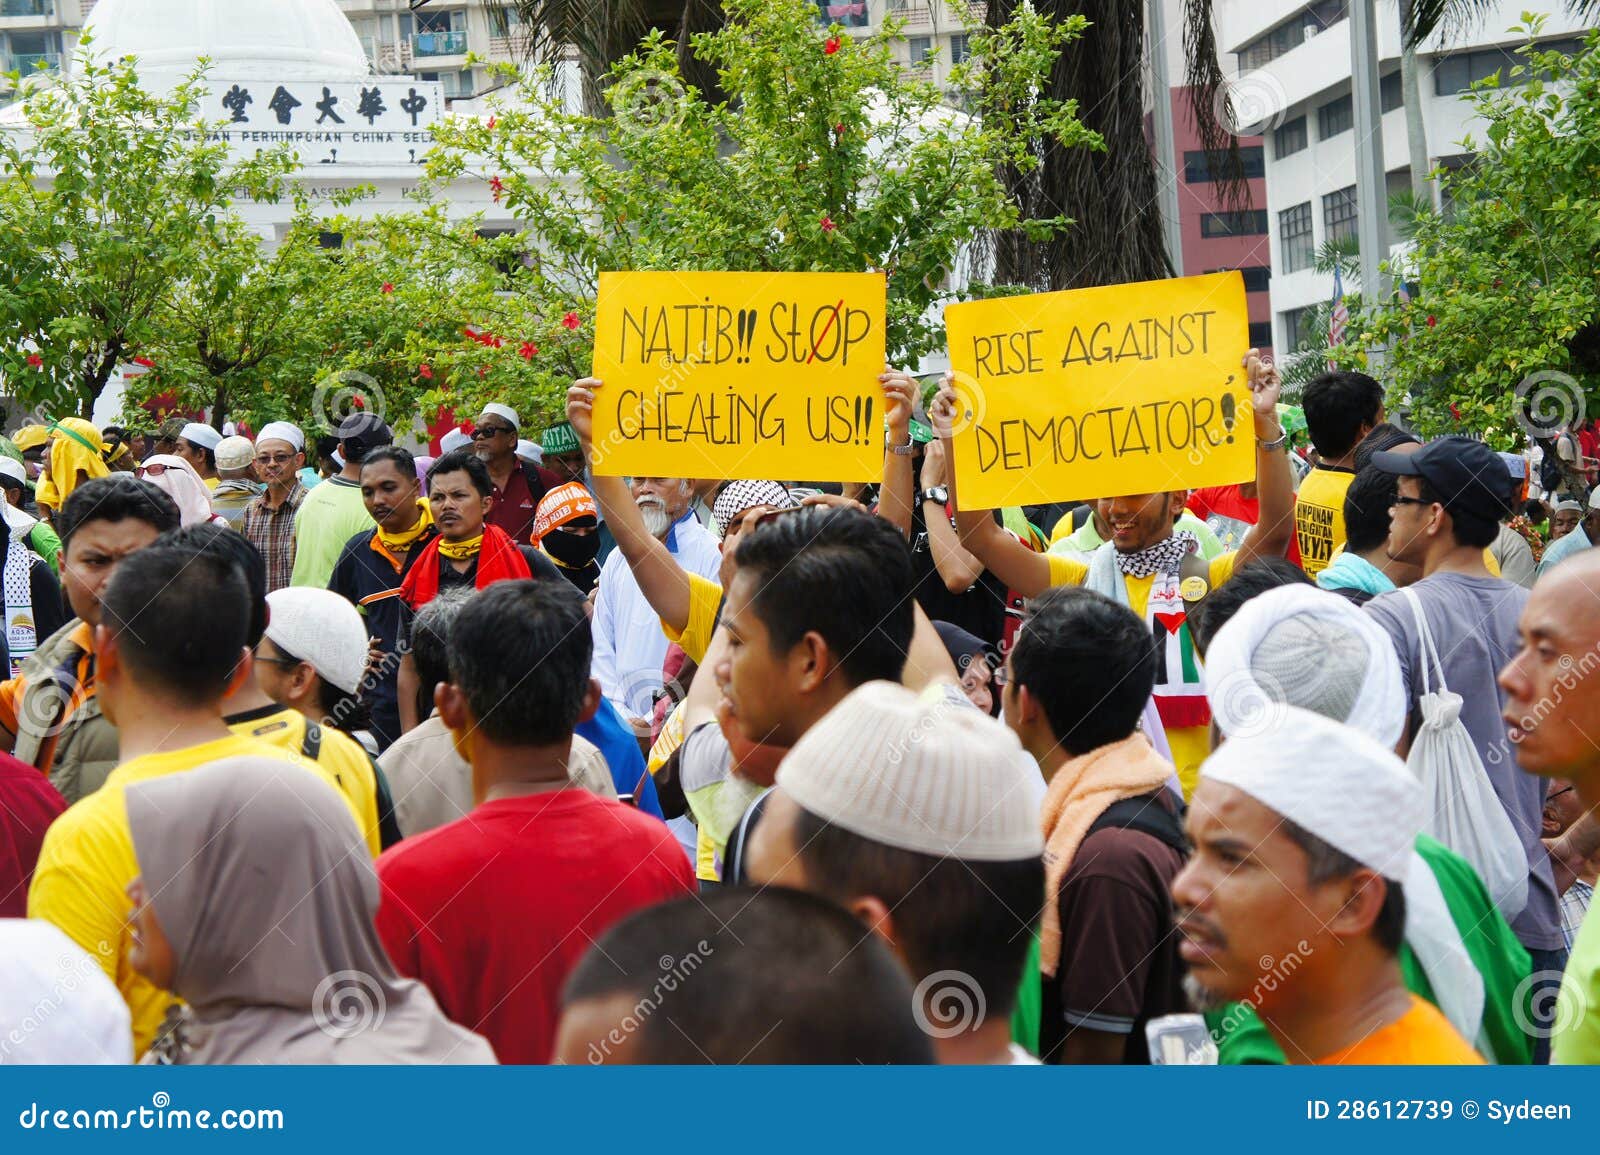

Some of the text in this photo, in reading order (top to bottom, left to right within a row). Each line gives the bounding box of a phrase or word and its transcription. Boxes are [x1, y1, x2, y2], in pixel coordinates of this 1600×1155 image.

[352, 131, 393, 142] CHINA
[403, 131, 436, 142] SELA
[973, 311, 1216, 378] RISE AGAINST
[807, 395, 873, 446] US!!
